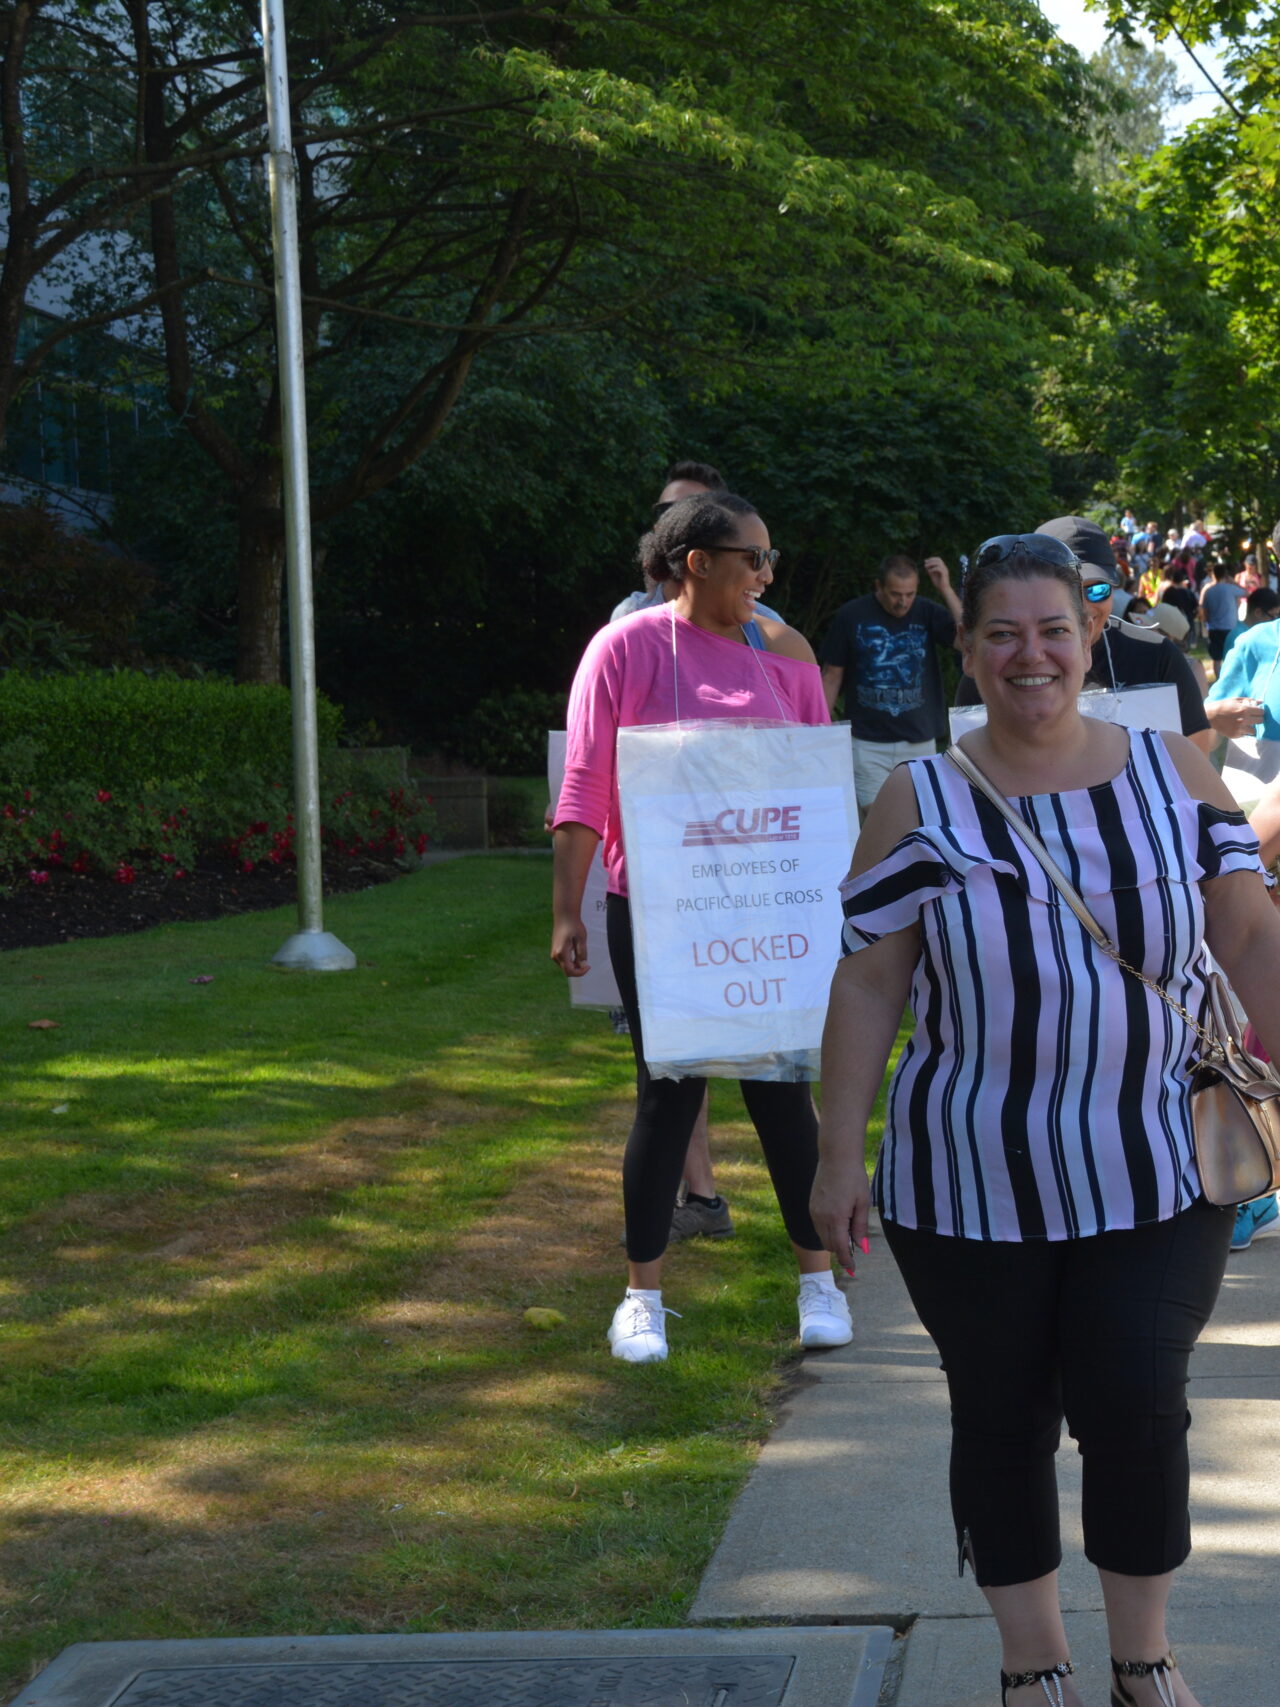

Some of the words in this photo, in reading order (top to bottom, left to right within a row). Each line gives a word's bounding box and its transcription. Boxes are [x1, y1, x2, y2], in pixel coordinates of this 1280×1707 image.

[714, 805, 801, 835] CUPE
[692, 861, 777, 879] EMPLOYEES
[780, 859, 800, 873] OF
[676, 895, 731, 912] PACIFIC
[734, 892, 771, 909] BLUE
[774, 889, 823, 905] CROSS
[693, 933, 809, 967] LOCKED
[724, 978, 786, 1008] OUT
